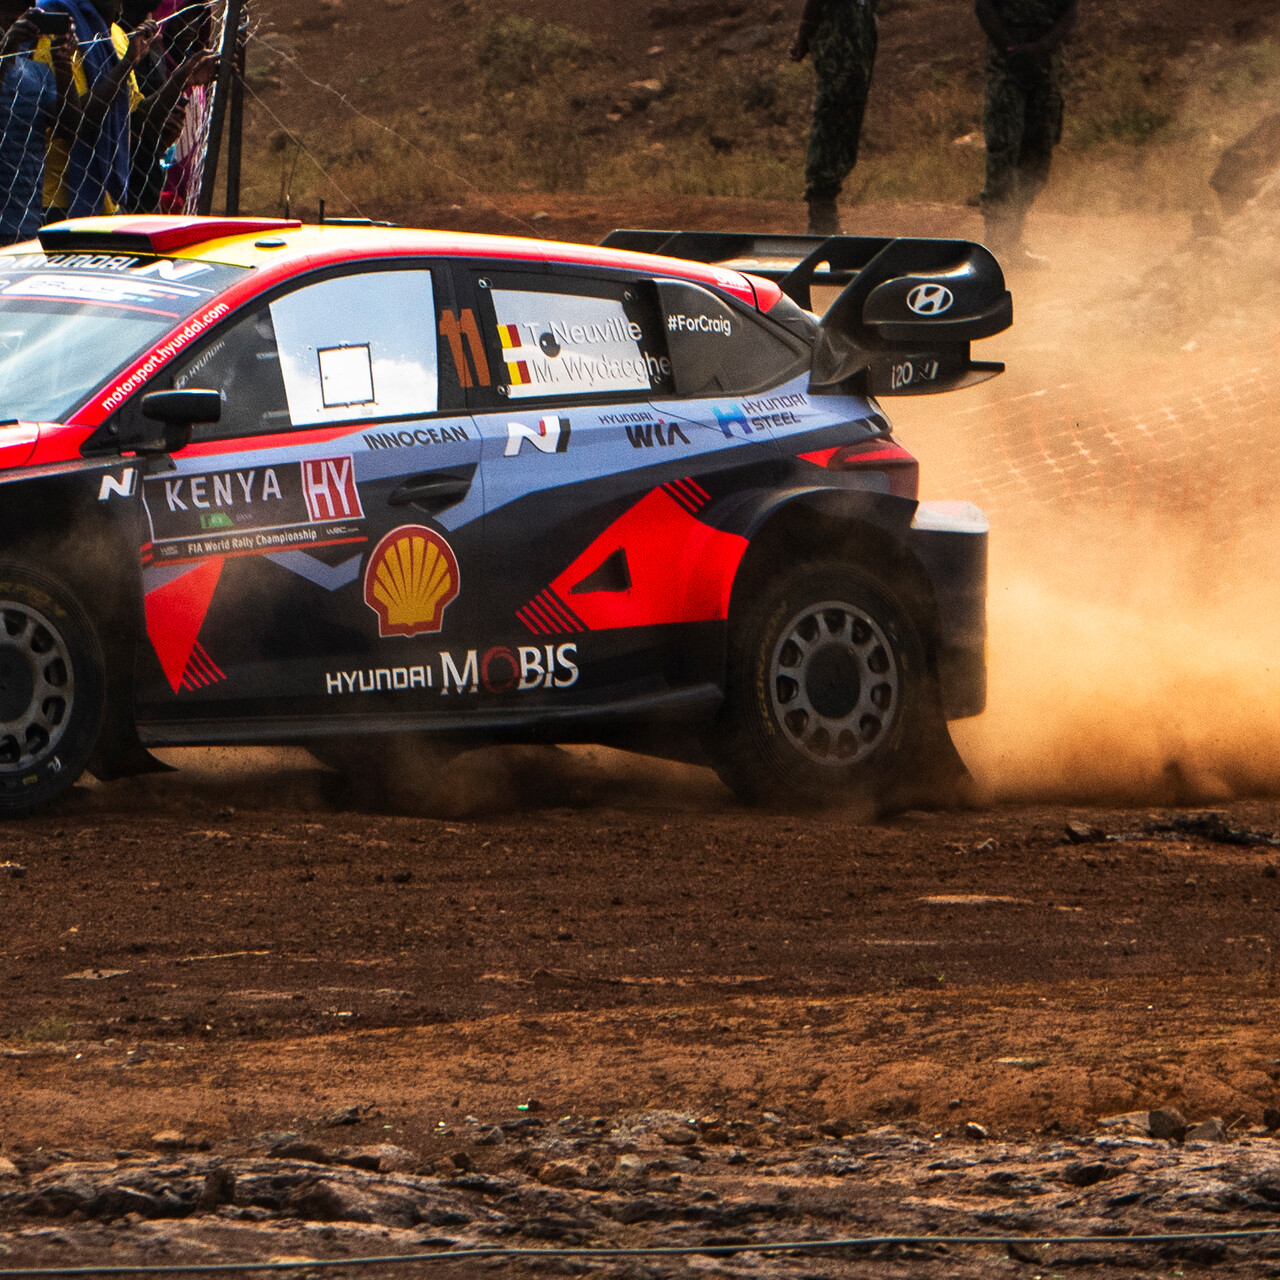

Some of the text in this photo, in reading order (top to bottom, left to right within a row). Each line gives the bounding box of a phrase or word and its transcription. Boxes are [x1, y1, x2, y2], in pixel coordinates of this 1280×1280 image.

[11, 253, 139, 271] HYUNDAI
[547, 318, 643, 346] Neuville
[667, 314, 732, 337] #ForCraig
[101, 302, 230, 411] motorsport.hyundai.com
[440, 308, 491, 388] 11
[532, 350, 671, 387] M. Wydaeghe
[742, 393, 808, 415] HYUNDAI
[598, 411, 654, 425] HYUNDAI
[752, 411, 802, 432] STEEL
[363, 425, 470, 452] INNOCEAN
[165, 459, 351, 519] KENYA HY
[187, 528, 318, 554] FIA World Rally Championship
[326, 642, 580, 696] HYUNDAI MOBIS
